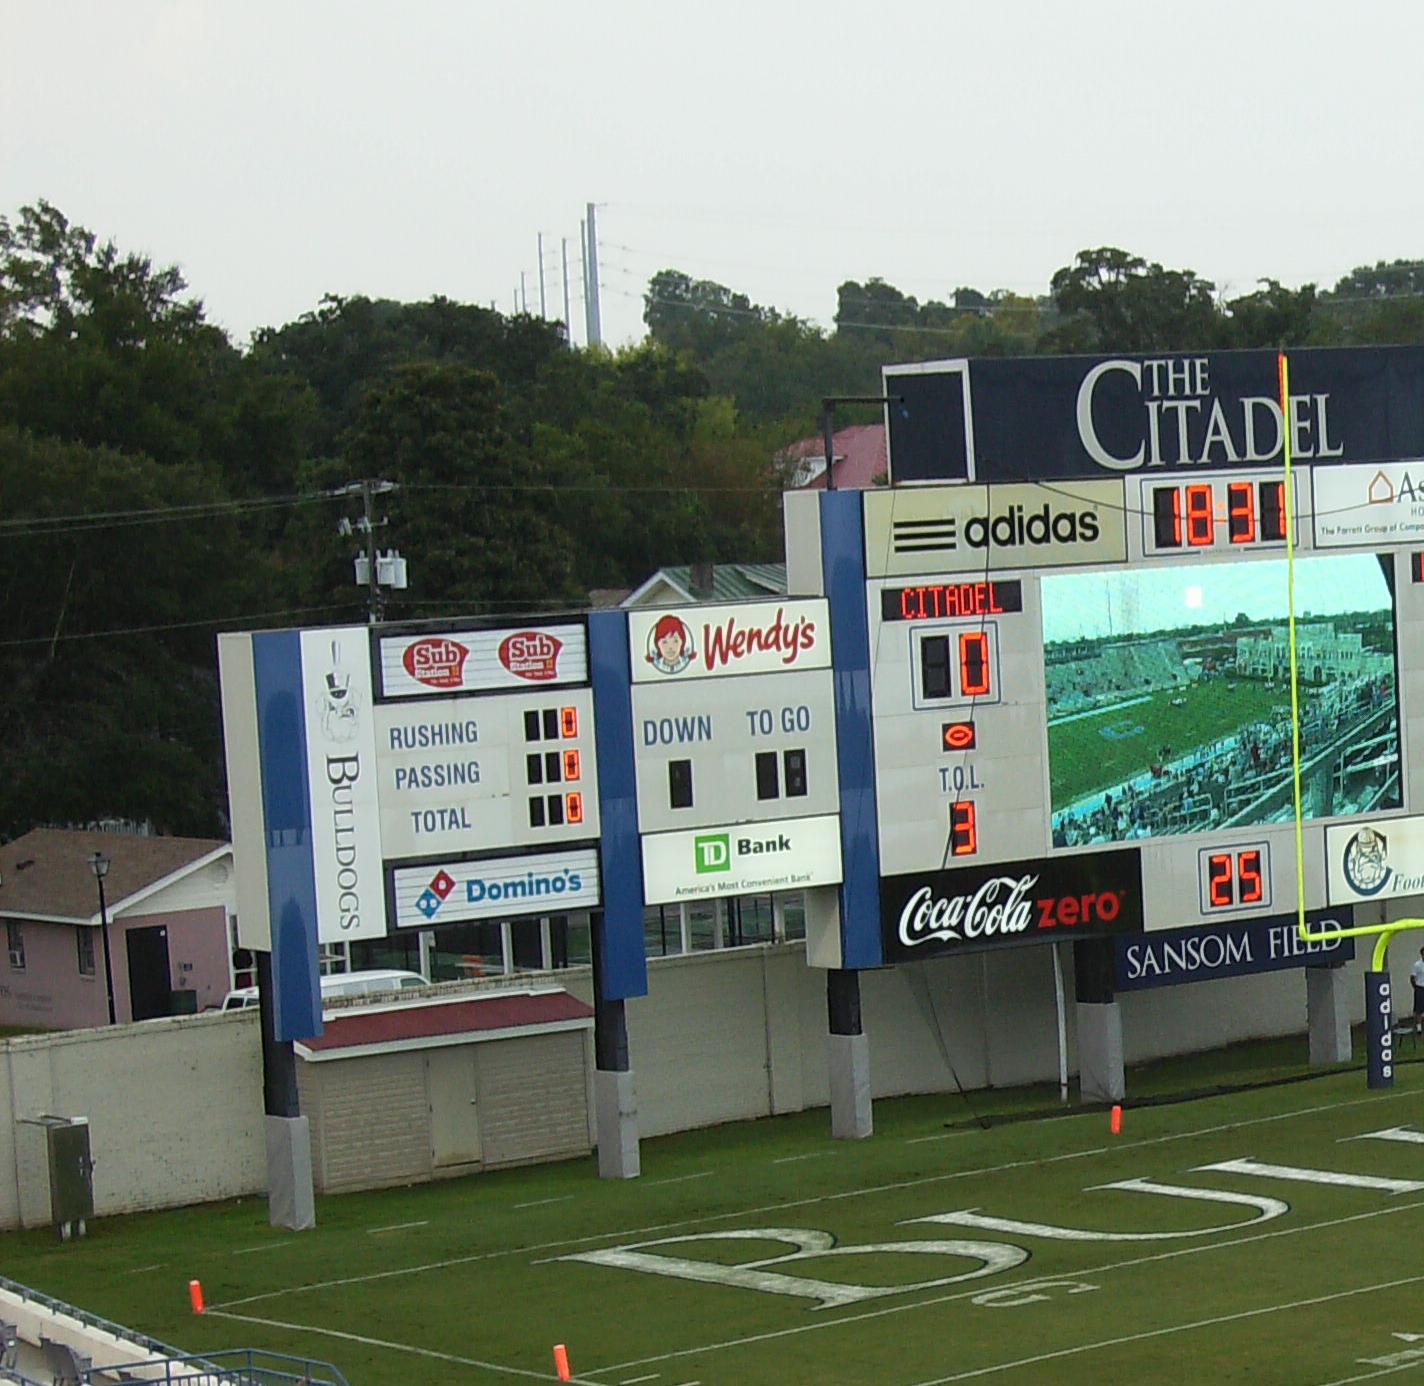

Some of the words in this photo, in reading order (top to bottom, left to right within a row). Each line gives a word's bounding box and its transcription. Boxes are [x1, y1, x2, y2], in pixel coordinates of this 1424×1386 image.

[1144, 358, 1210, 396] THE
[1077, 360, 1343, 470] CITADEL
[964, 504, 1099, 548] adidas
[1173, 482, 1287, 544] 18:31
[902, 582, 1003, 619] CITADEL
[413, 641, 460, 668] Sub
[509, 634, 554, 661] Sub
[703, 607, 815, 671] Wendy's
[960, 632, 989, 695] 0
[390, 721, 478, 749] RUSHING
[562, 707, 577, 738] 0
[643, 715, 712, 746] DOWN
[746, 709, 773, 736] TO
[781, 706, 810, 733] GO
[396, 761, 480, 790] PASSING
[564, 750, 580, 781] 0
[939, 765, 984, 792] T.O.L.
[411, 807, 471, 833] TOTAL
[566, 792, 582, 824] 0
[326, 752, 360, 930] BULLDOGS
[954, 801, 976, 854] 3
[698, 840, 727, 866] TD
[738, 835, 791, 855] Bank
[466, 868, 582, 902] Domino's
[675, 883, 715, 895] America's
[718, 881, 738, 890] Most
[742, 874, 788, 888] Convenient
[791, 873, 811, 882] Bank
[1211, 851, 1262, 905] 25
[1037, 890, 1121, 929] zero
[1126, 931, 1254, 979] SANSOM
[1268, 920, 1342, 960] FIELD
